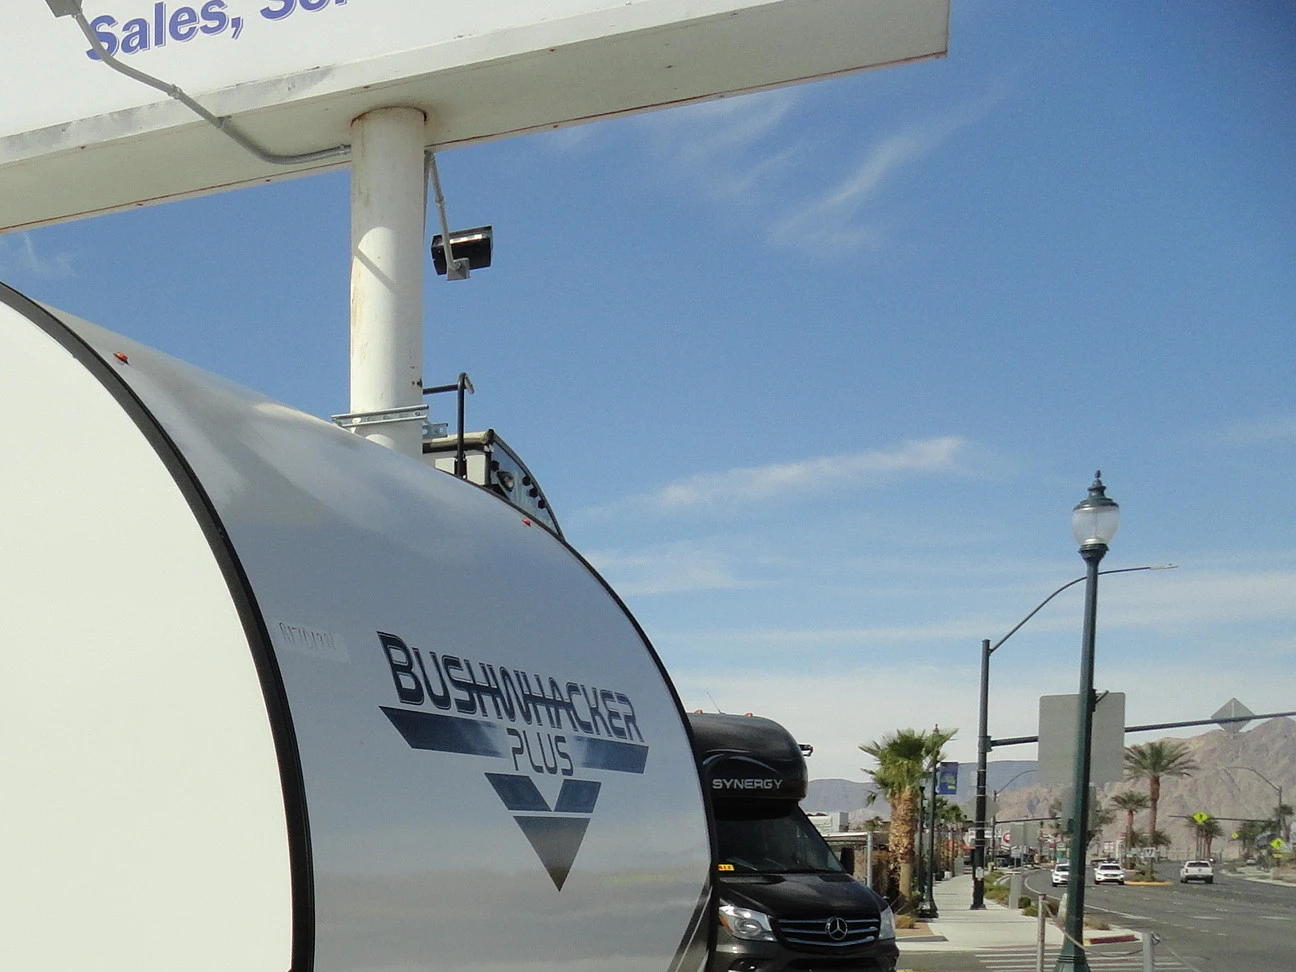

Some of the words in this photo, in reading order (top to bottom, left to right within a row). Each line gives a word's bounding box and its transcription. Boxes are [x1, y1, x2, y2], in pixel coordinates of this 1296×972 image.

[85, 0, 244, 61] Sales,
[376, 630, 644, 743] BUSHWHACKER
[506, 727, 574, 777] PLUS
[712, 778, 783, 790] SYNERGY
